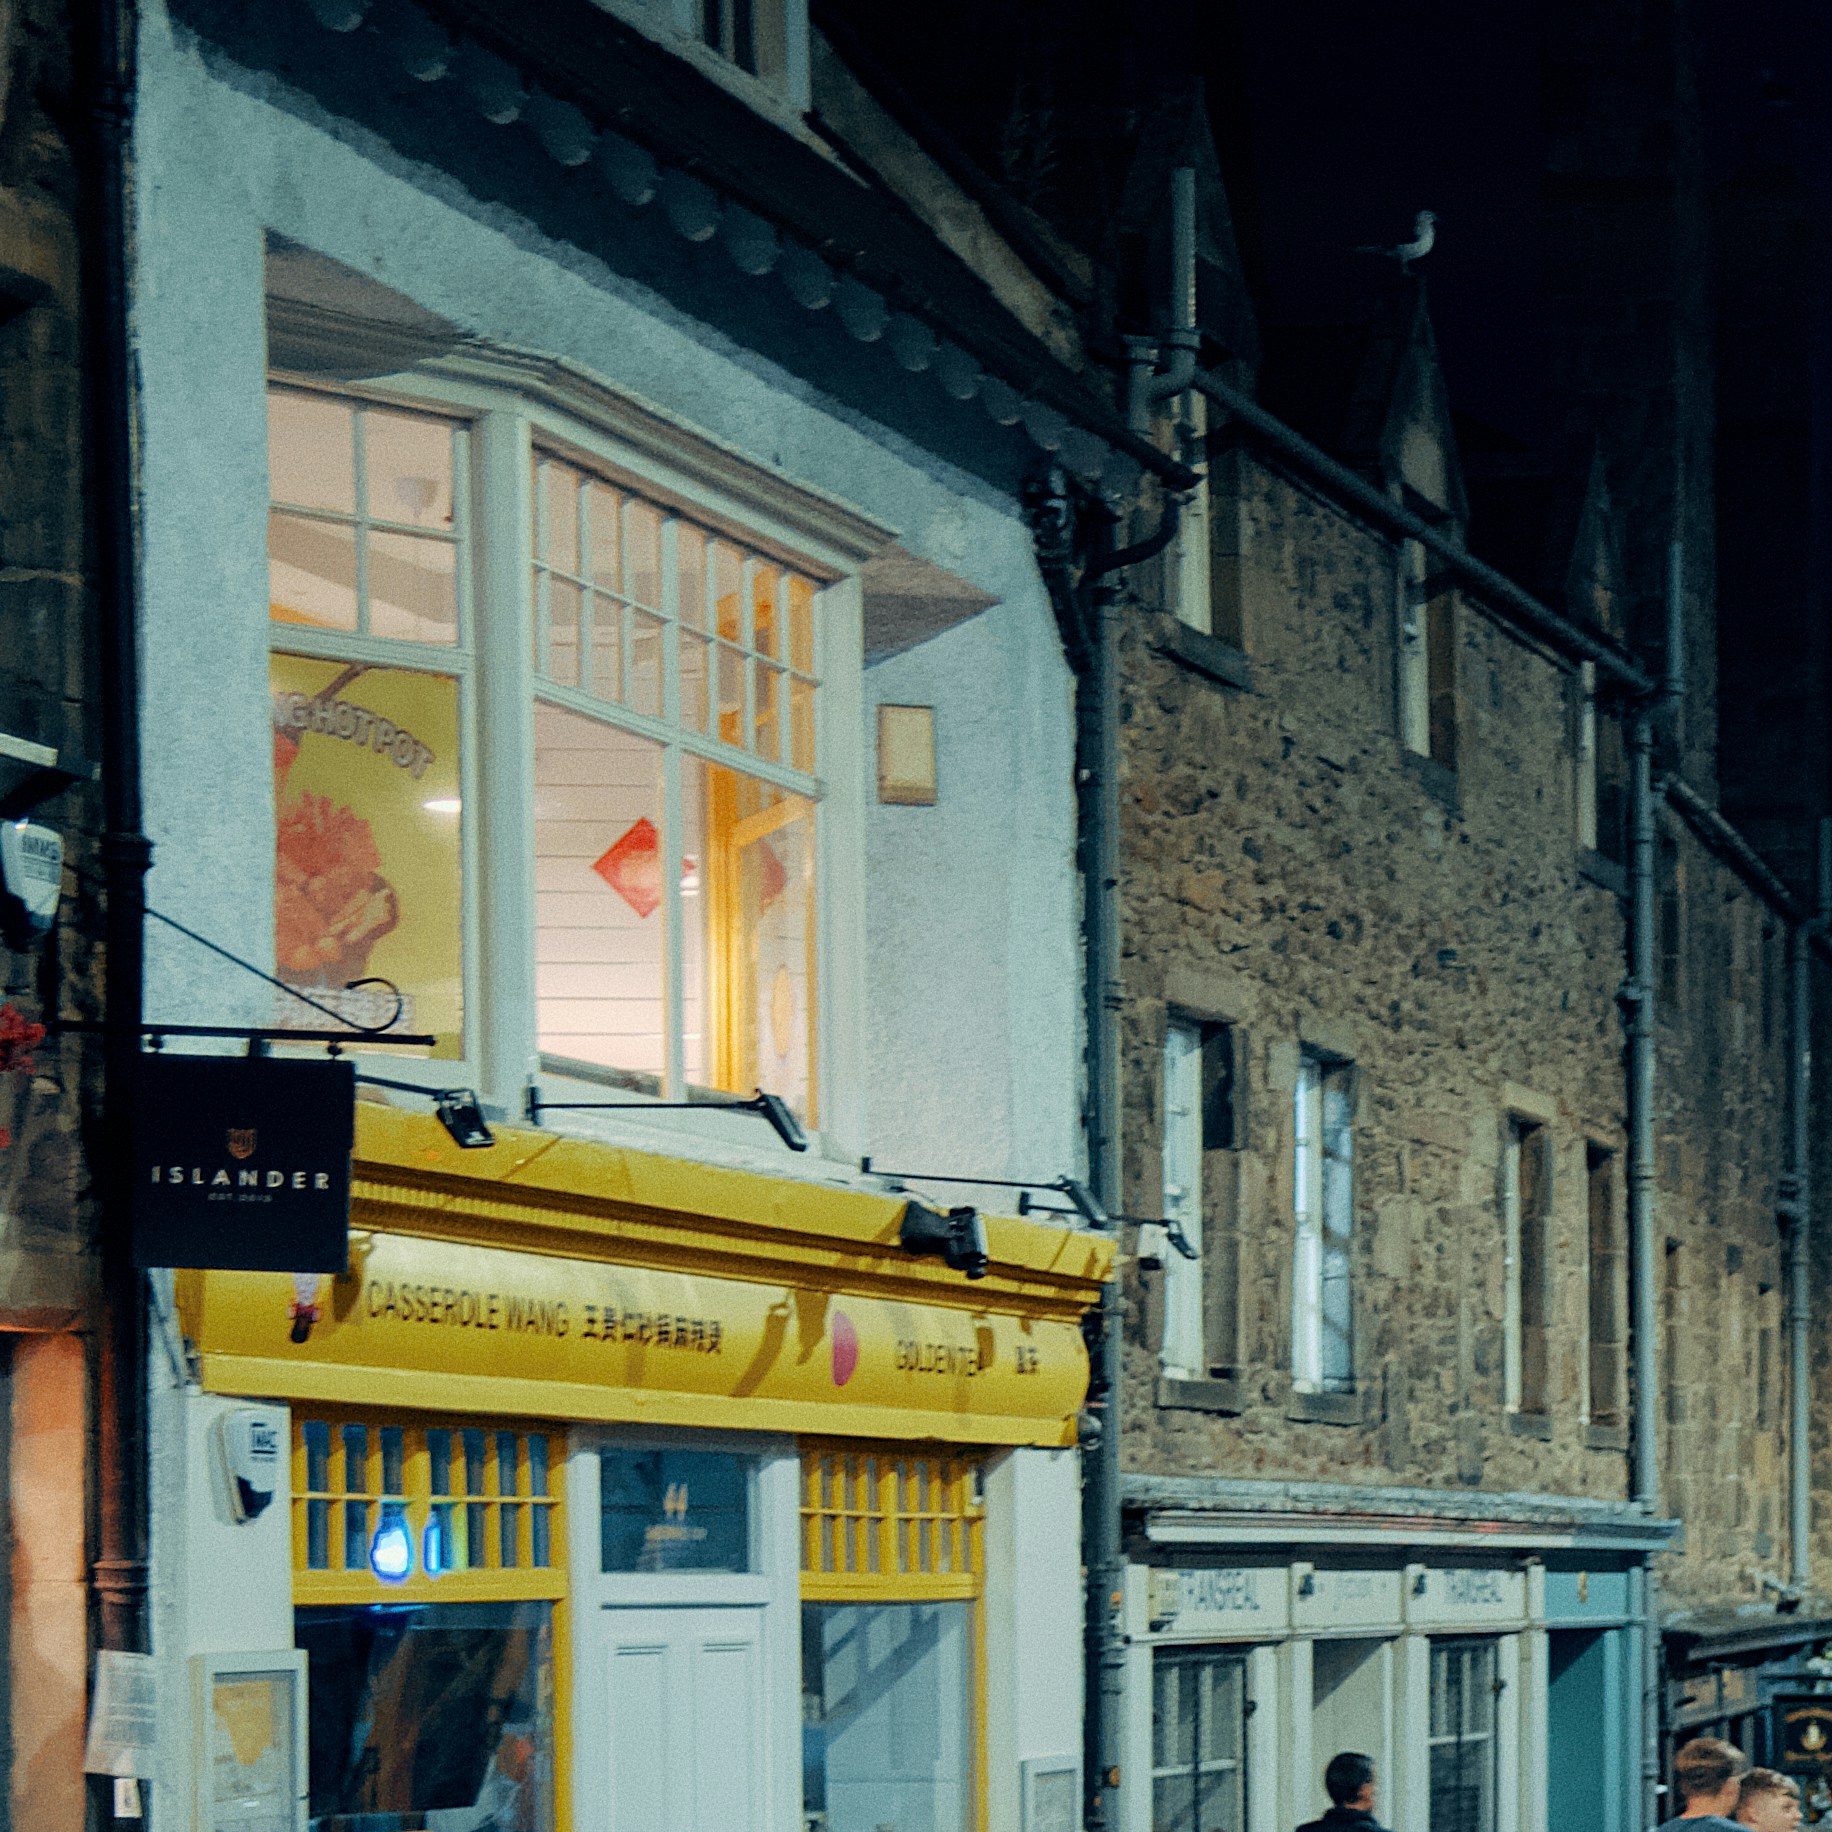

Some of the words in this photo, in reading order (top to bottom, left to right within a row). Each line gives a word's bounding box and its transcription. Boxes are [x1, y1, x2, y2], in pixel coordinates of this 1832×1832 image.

[151, 1165, 330, 1190] ISLANDER
[366, 1280, 499, 1331] CASSEROLE
[504, 1295, 570, 1338] WANG
